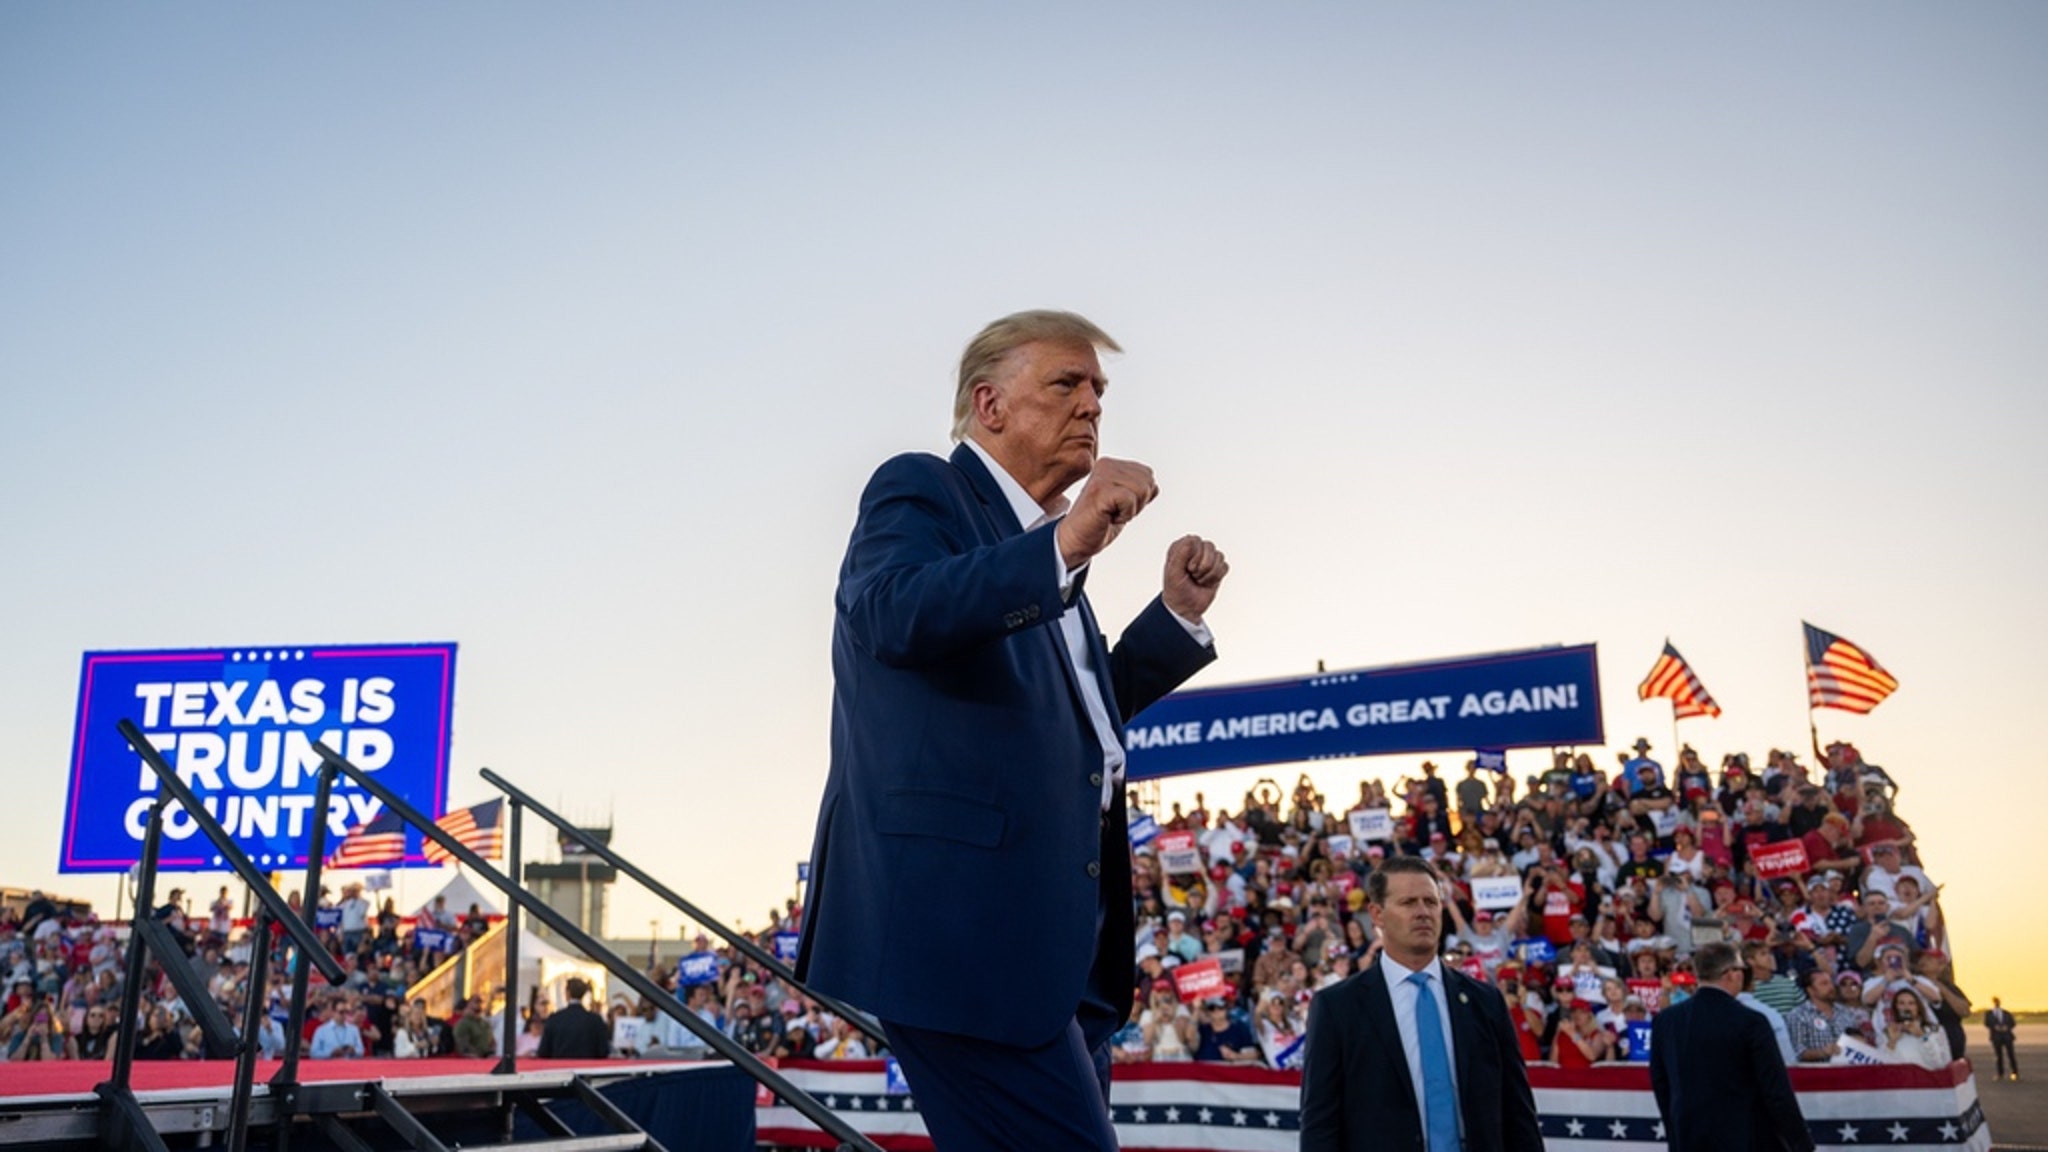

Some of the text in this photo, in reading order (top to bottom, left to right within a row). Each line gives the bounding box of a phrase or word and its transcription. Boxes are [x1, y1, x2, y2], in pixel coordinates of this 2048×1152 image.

[135, 677, 395, 727] TEXAS IS
[1126, 684, 1578, 750] MAKE AMERICA GREAT AGAIN!
[129, 729, 394, 791] TRUMP
[124, 794, 384, 841] COUNTRY
[1757, 855, 1804, 871] TRUMP
[1845, 1046, 1884, 1064] TRU
